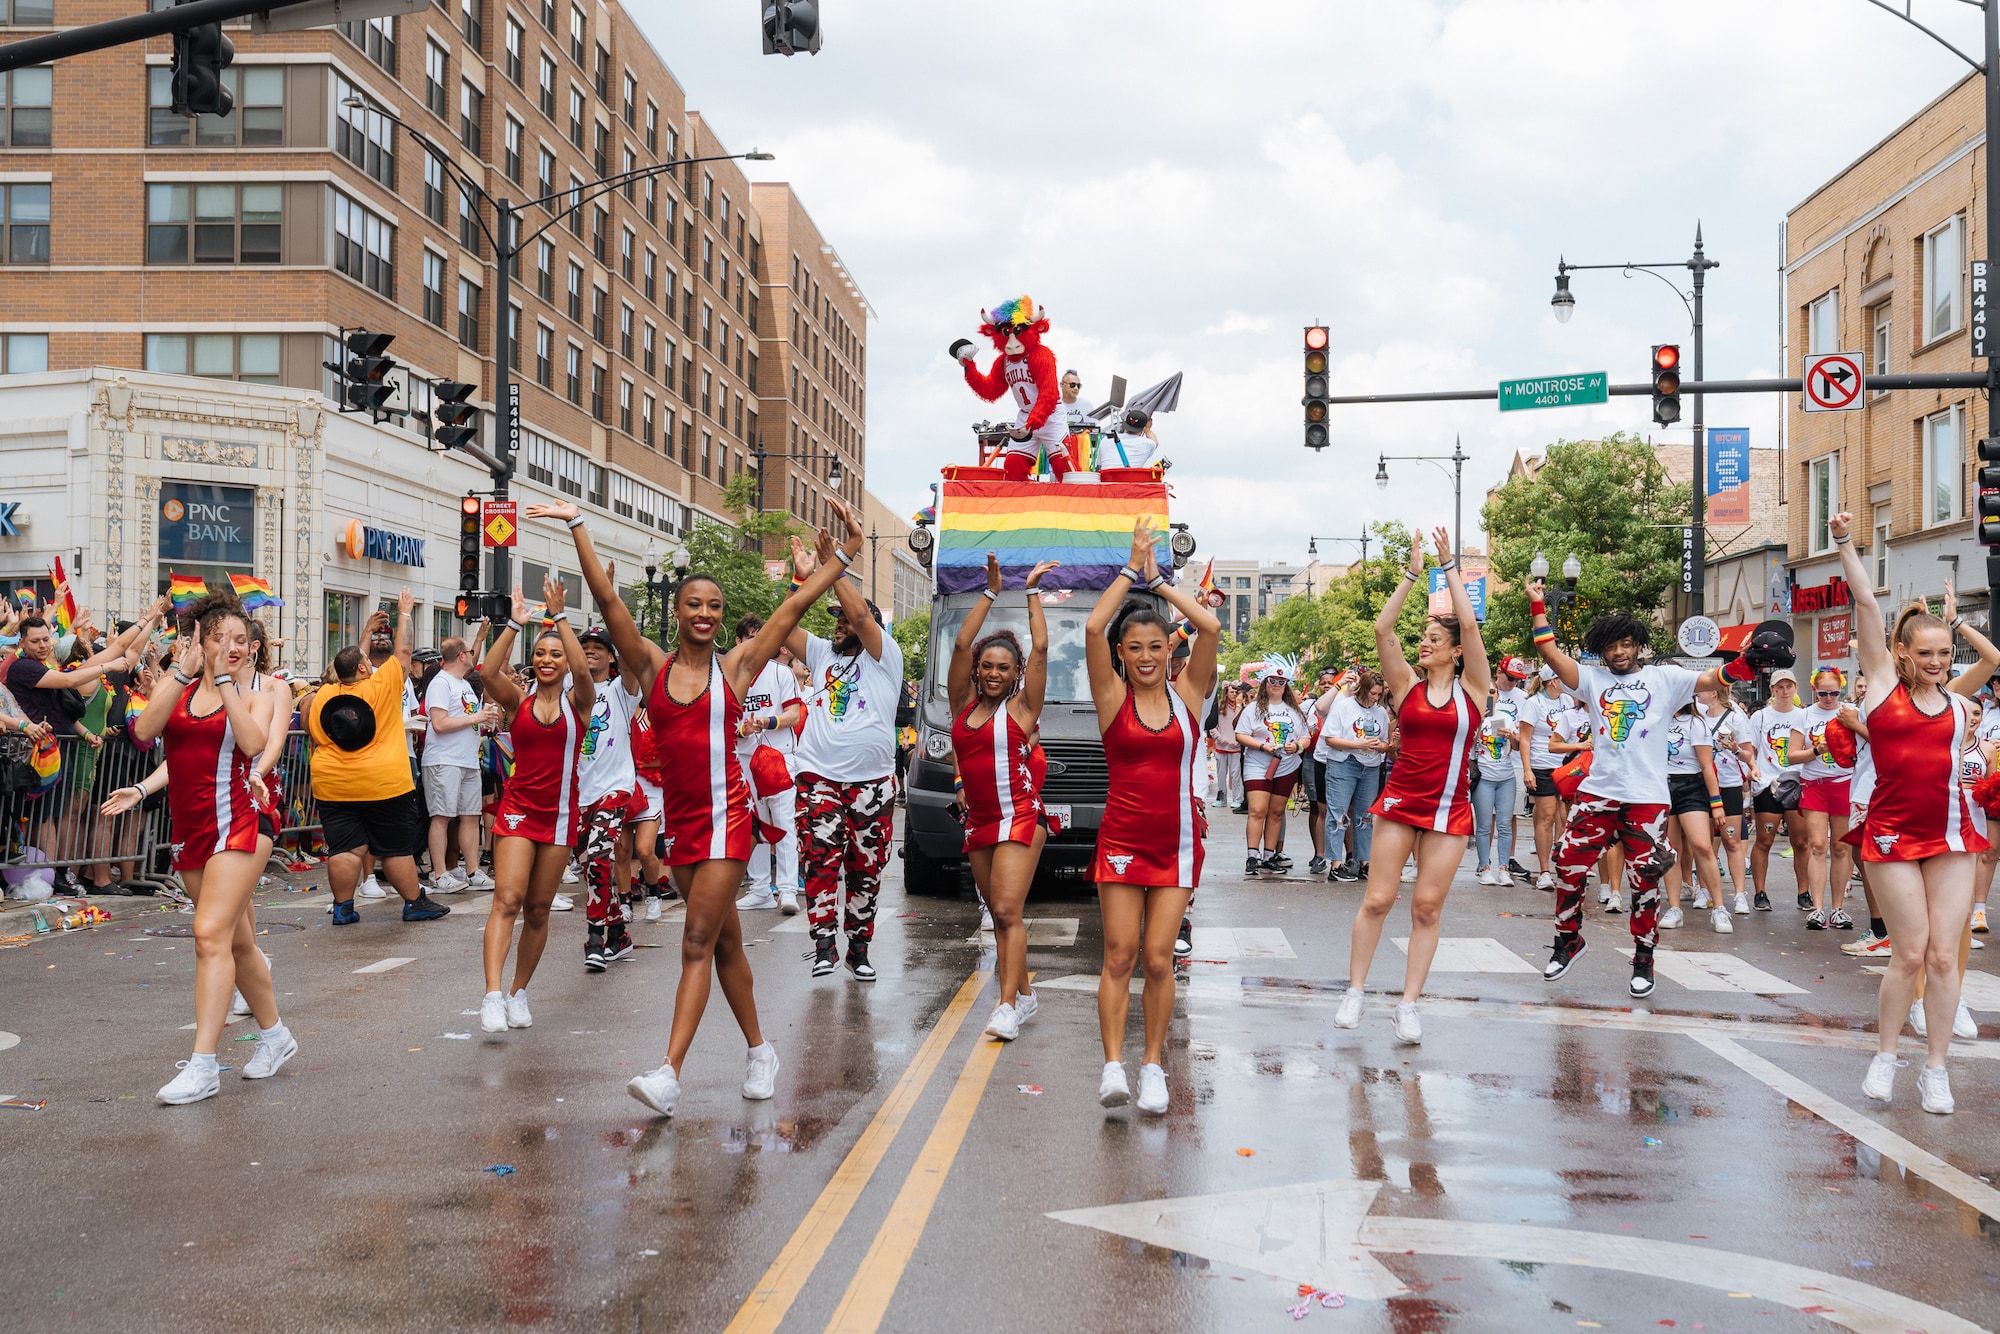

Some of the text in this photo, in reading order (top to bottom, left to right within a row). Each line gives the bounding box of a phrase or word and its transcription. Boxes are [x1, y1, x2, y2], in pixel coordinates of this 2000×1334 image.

[1973, 262, 1987, 356] BR4401
[1019, 386, 1031, 406] 1
[1504, 377, 1602, 396] W MONTROSE AV
[1535, 393, 1572, 405] 4400 N
[509, 384, 519, 450] BR4400
[186, 503, 231, 522] PNC
[186, 522, 241, 543] BANK
[364, 526, 426, 568] PNC BANK
[1683, 528, 1693, 593] BR4403
[1771, 557, 1781, 619] FALA
[1791, 583, 1828, 613] LIBERTY
[1694, 629, 1705, 643] L
[744, 693, 771, 704] CREDI
